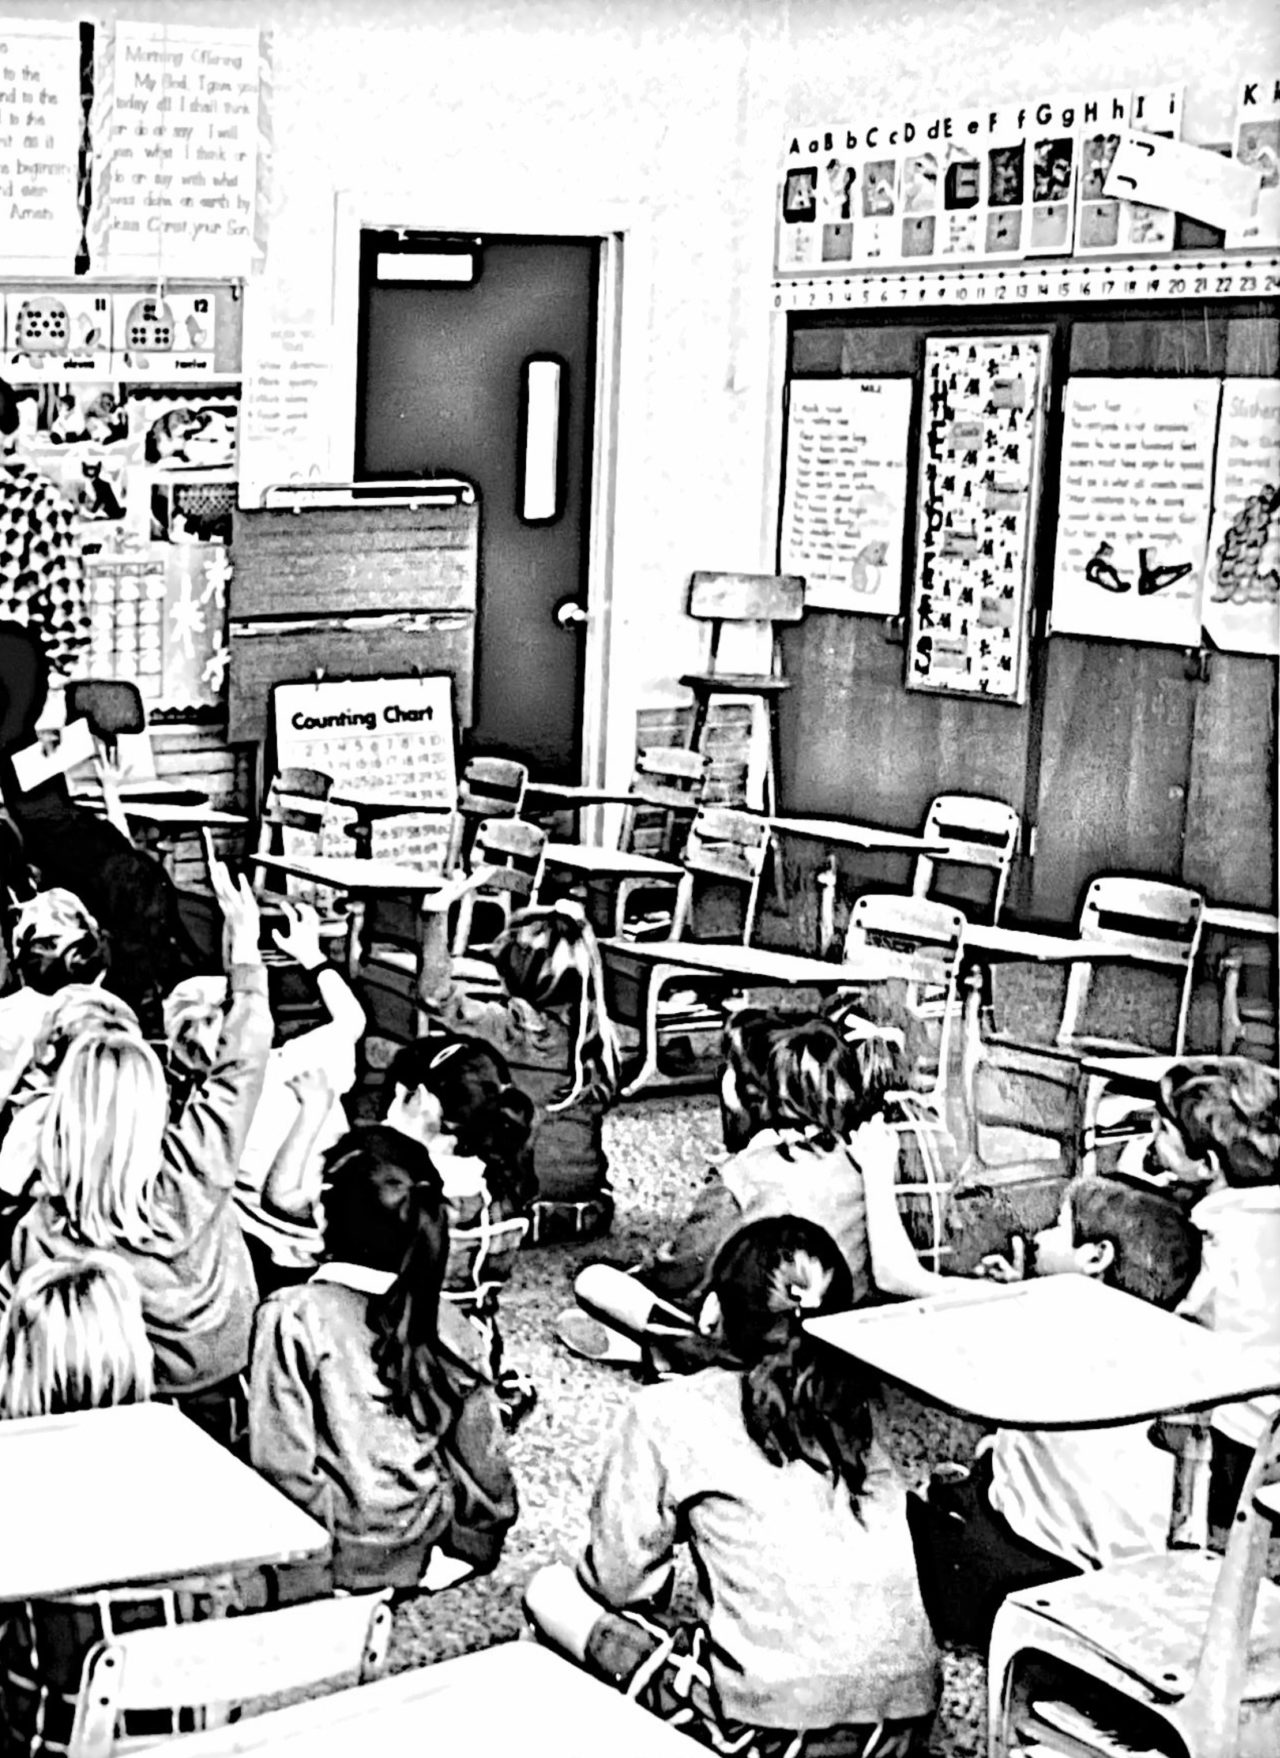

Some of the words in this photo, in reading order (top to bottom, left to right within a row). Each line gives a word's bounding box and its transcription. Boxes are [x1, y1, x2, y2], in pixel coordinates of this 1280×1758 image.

[790, 138, 800, 154] A
[809, 140, 818, 153] a
[824, 133, 833, 151] B
[847, 131, 857, 149] b
[866, 127, 878, 148] C
[889, 131, 898, 144] c
[904, 123, 915, 143] D
[928, 120, 939, 139] d
[944, 118, 952, 138] E
[968, 121, 978, 134] e
[989, 113, 997, 132] F
[1018, 109, 1025, 129] f
[1036, 104, 1052, 125] G
[1062, 109, 1074, 128] g
[1085, 102, 1097, 122] H
[1113, 98, 1123, 119] h
[1244, 84, 1258, 105] K
[774, 294, 782, 308] 0
[809, 293, 815, 306] 2
[844, 293, 852, 302] 4
[863, 290, 869, 303] 5
[880, 291, 888, 303] 6
[899, 289, 908, 299] 7
[956, 287, 968, 300] 10
[977, 287, 985, 298] 11
[995, 285, 1006, 300] 12
[1016, 284, 1028, 298] 13
[1038, 284, 1049, 295] 14
[1058, 282, 1070, 297] 15
[1080, 282, 1091, 296] 16
[1102, 280, 1115, 294] 17
[1124, 280, 1137, 294] 18
[1147, 279, 1160, 292] 19
[1169, 278, 1186, 294] 20
[1194, 277, 1208, 293] 21
[1215, 276, 1233, 293] 22
[1240, 276, 1257, 292] 23
[95, 298, 106, 312] 11
[193, 298, 209, 314] 12
[292, 710, 377, 730] Counting
[383, 705, 433, 723] Chart
